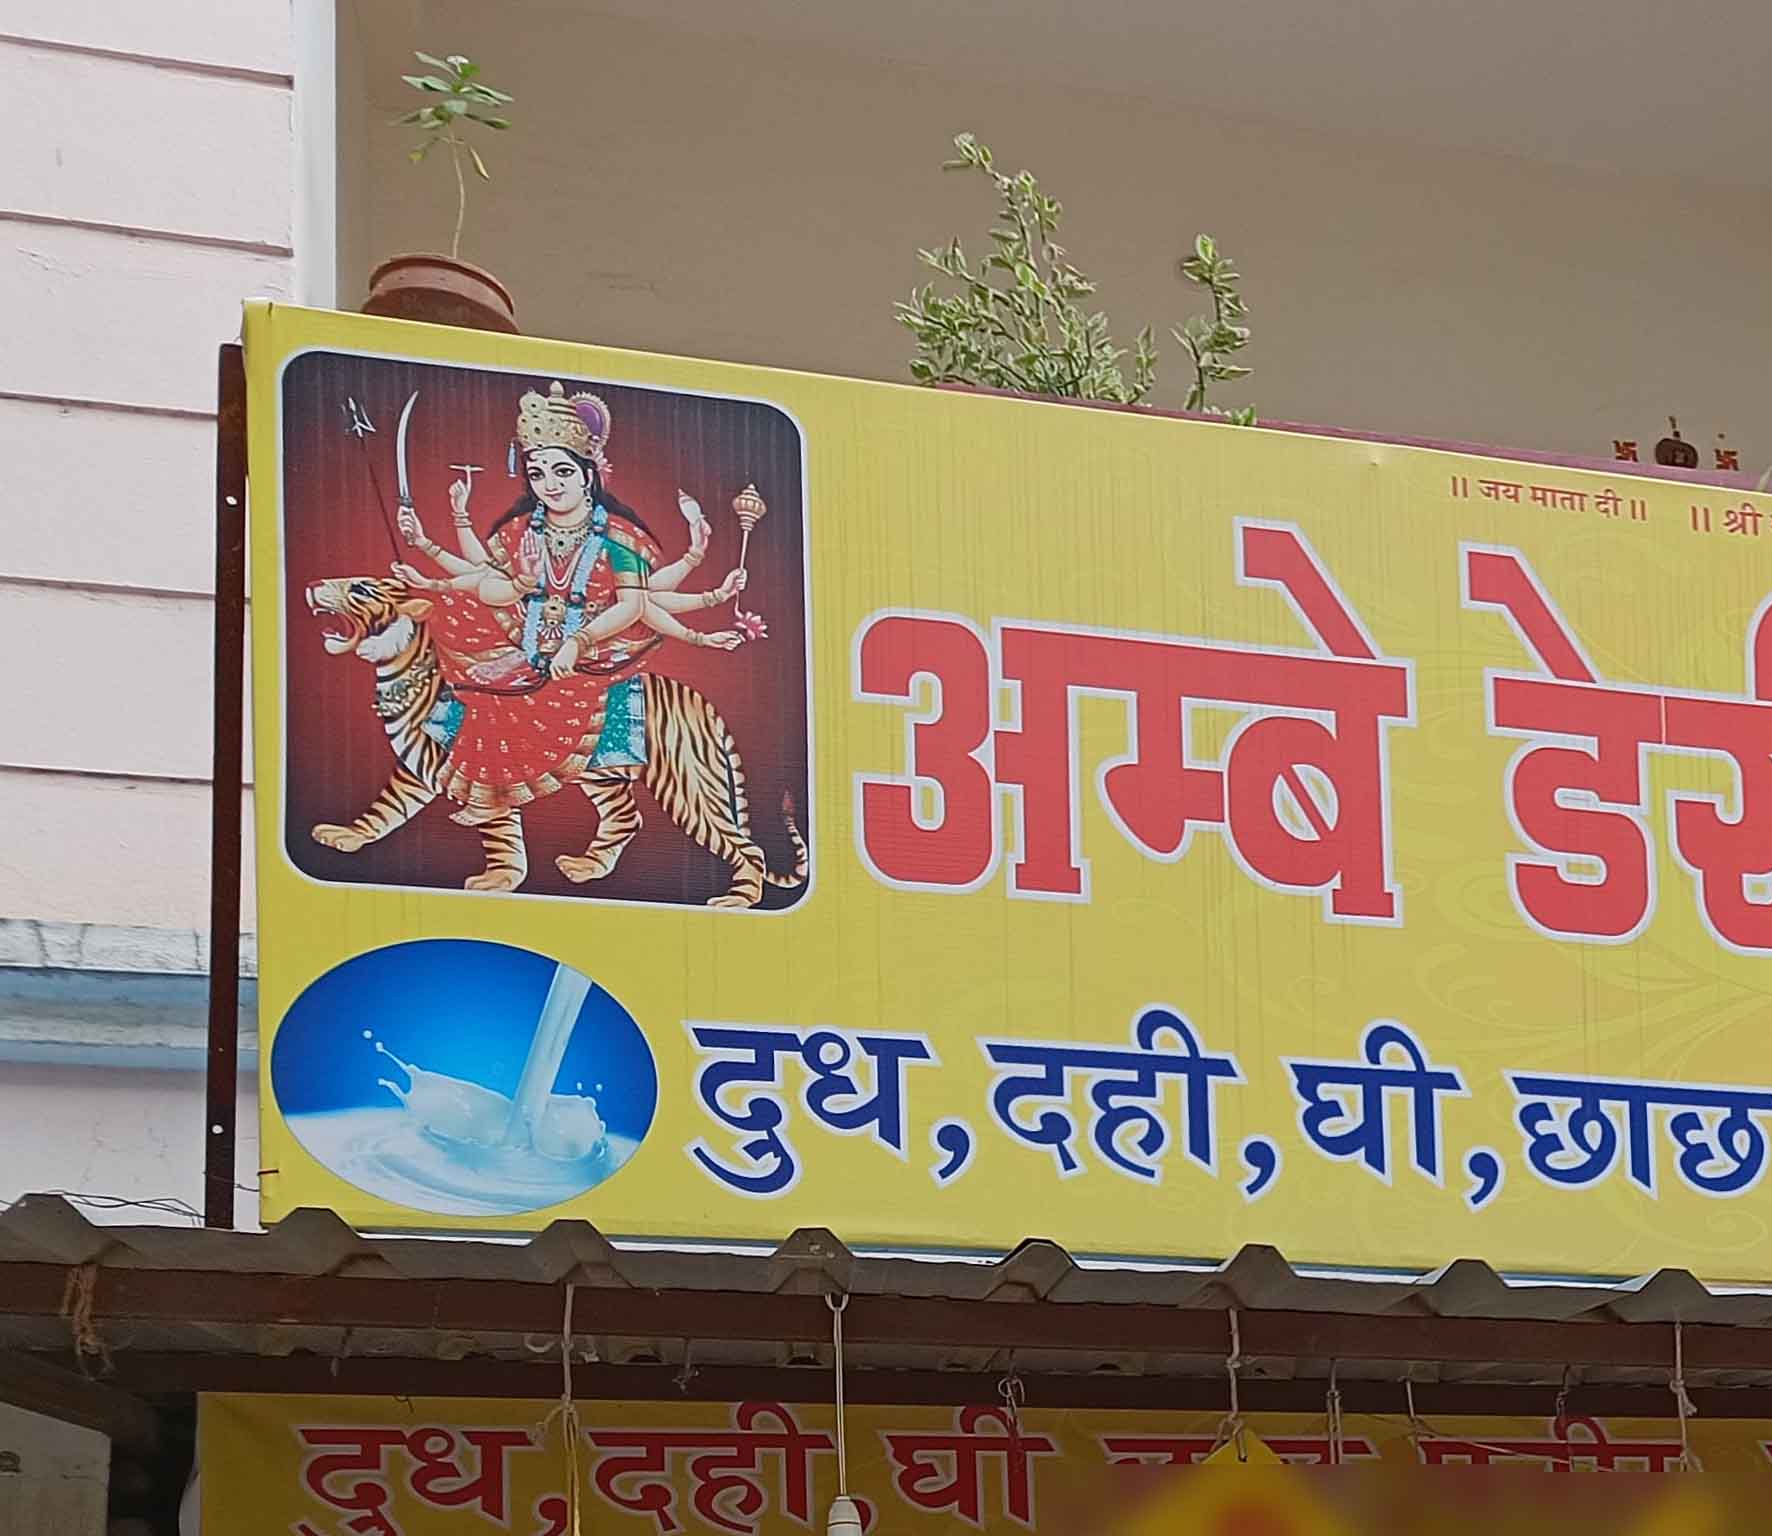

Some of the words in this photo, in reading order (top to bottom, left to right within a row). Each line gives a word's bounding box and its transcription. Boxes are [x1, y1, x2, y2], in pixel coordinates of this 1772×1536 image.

[1479, 479, 1522, 503] जय
[1530, 486, 1586, 512] माता
[1595, 489, 1622, 517] दी
[1723, 503, 1762, 536] श्री
[858, 524, 1409, 919] अम्बे
